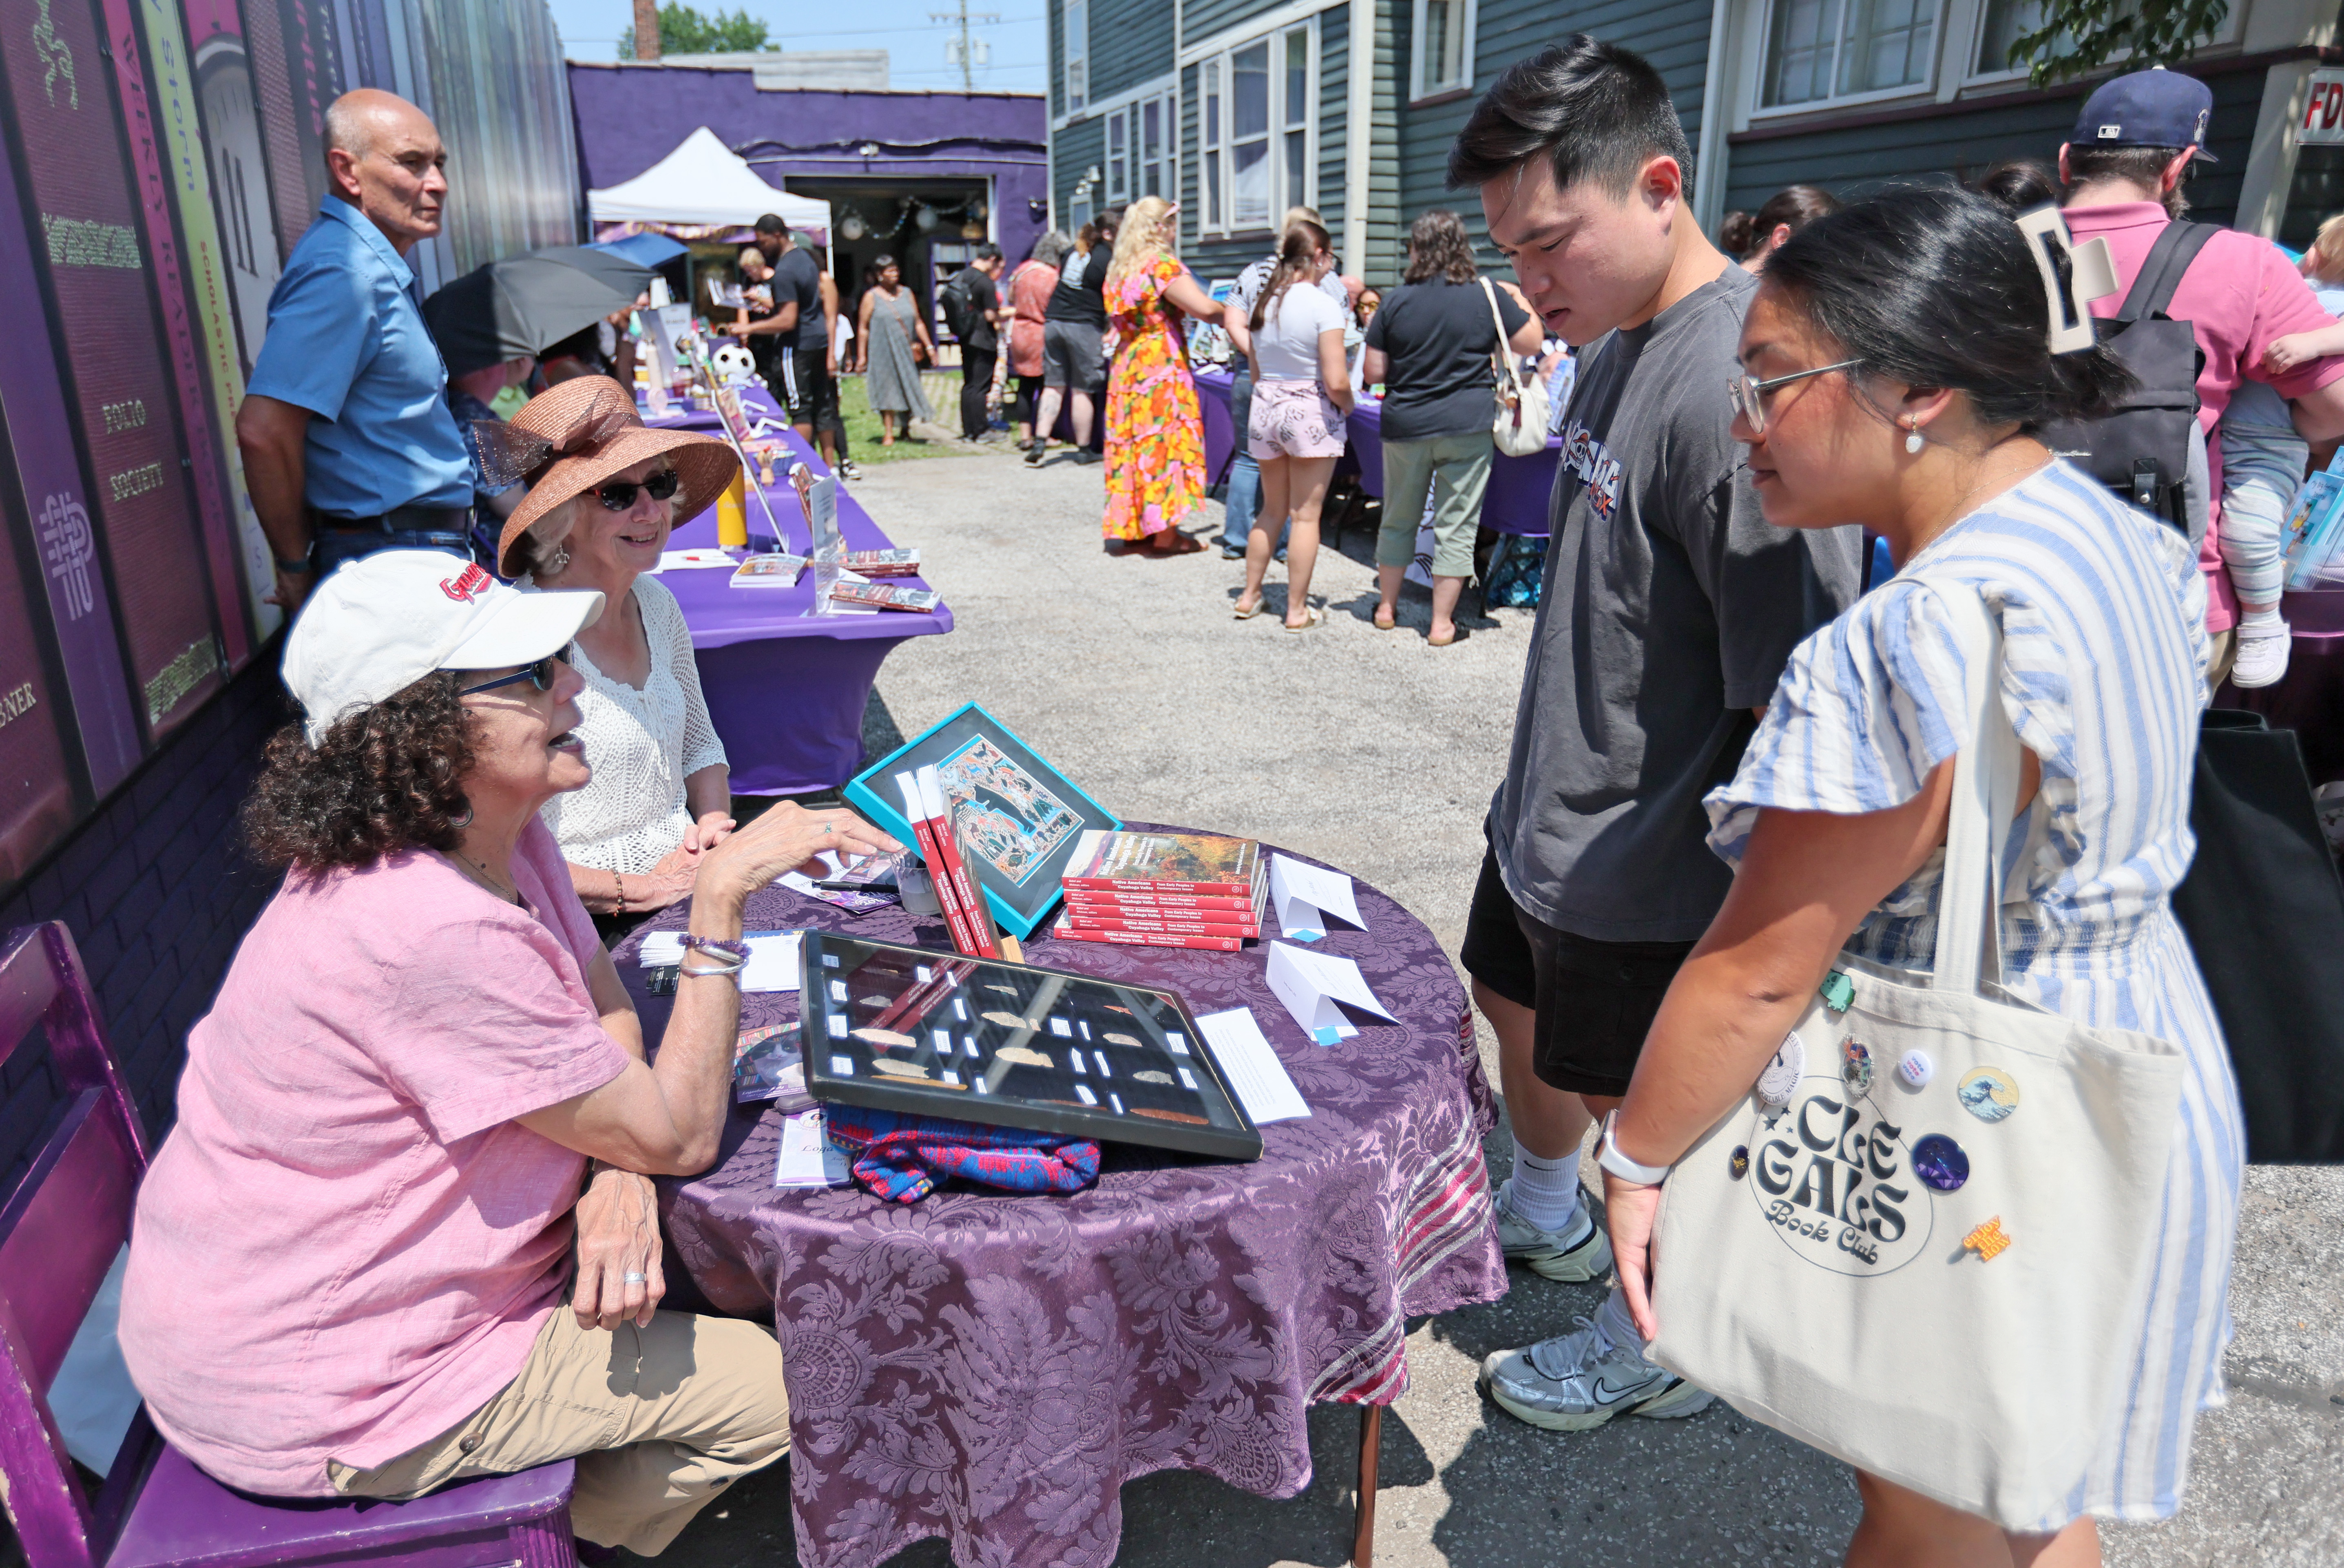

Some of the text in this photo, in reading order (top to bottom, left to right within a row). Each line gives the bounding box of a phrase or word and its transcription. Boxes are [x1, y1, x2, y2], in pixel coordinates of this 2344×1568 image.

[123, 34, 163, 212] WEEKLY
[163, 39, 195, 191] Storm
[2304, 83, 2344, 130] FD
[200, 241, 229, 372] SCHOLASTIC
[102, 400, 147, 435] FOLIO
[109, 462, 164, 503] SOCIETY
[1099, 837, 1123, 875] Native Americans
[1115, 849, 1132, 869] Cuyahoga
[1124, 835, 1138, 849] Valley
[938, 879, 954, 914] Cuyahoga Valley
[946, 887, 958, 910] Americans
[955, 874, 965, 896] Cuyahoga
[964, 882, 975, 906] Americans
[953, 917, 964, 940] Contemporary
[970, 912, 980, 935] Contemporary
[1902, 1064, 1915, 1080] vote
[1907, 1060, 1919, 1076] vote
[1911, 1056, 1924, 1072] vote
[1760, 1070, 1800, 1103] PORTABLE MAGIC
[1797, 1095, 1902, 1180] CLE
[1755, 1138, 1909, 1243] GALS
[1765, 1198, 1878, 1265] Book Club
[1964, 1216, 1999, 1247] enjoy
[1978, 1231, 2001, 1250] the
[1981, 1236, 2010, 1260] now
